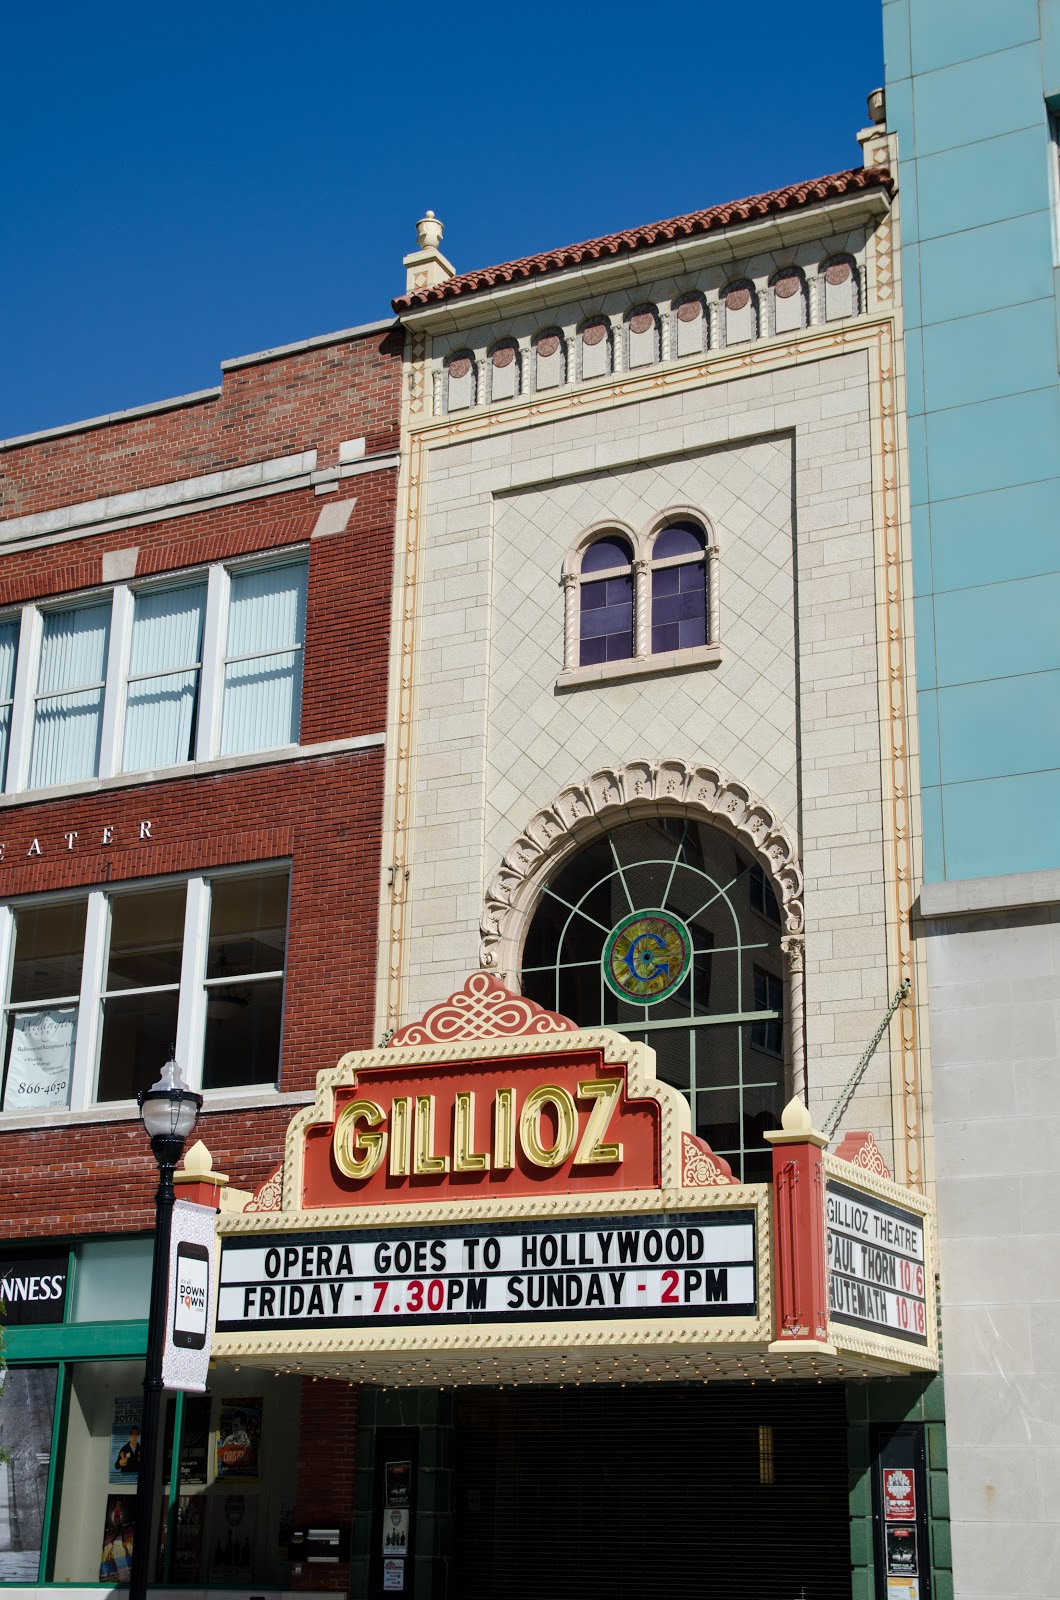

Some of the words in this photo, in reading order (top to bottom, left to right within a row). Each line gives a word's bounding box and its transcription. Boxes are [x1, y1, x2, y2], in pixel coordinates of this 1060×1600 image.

[17, 1080, 67, 1095] 866-4630
[333, 1078, 625, 1180] GILLIOZ
[827, 1197, 869, 1235] GILLIOZ
[873, 1215, 918, 1253] THEATRE
[264, 1244, 354, 1279] OPERA
[374, 1238, 447, 1273] GOES
[464, 1236, 502, 1271] TO
[521, 1227, 705, 1269] HOLLYWOOD
[827, 1235, 856, 1275] PAUL
[861, 1245, 897, 1288] THORN
[180, 1284, 205, 1298] DOWN
[243, 1282, 345, 1317] FRIDAY
[372, 1277, 488, 1314] 7.30PM
[506, 1271, 627, 1309] SUNDAY
[660, 1268, 729, 1304] 2PM
